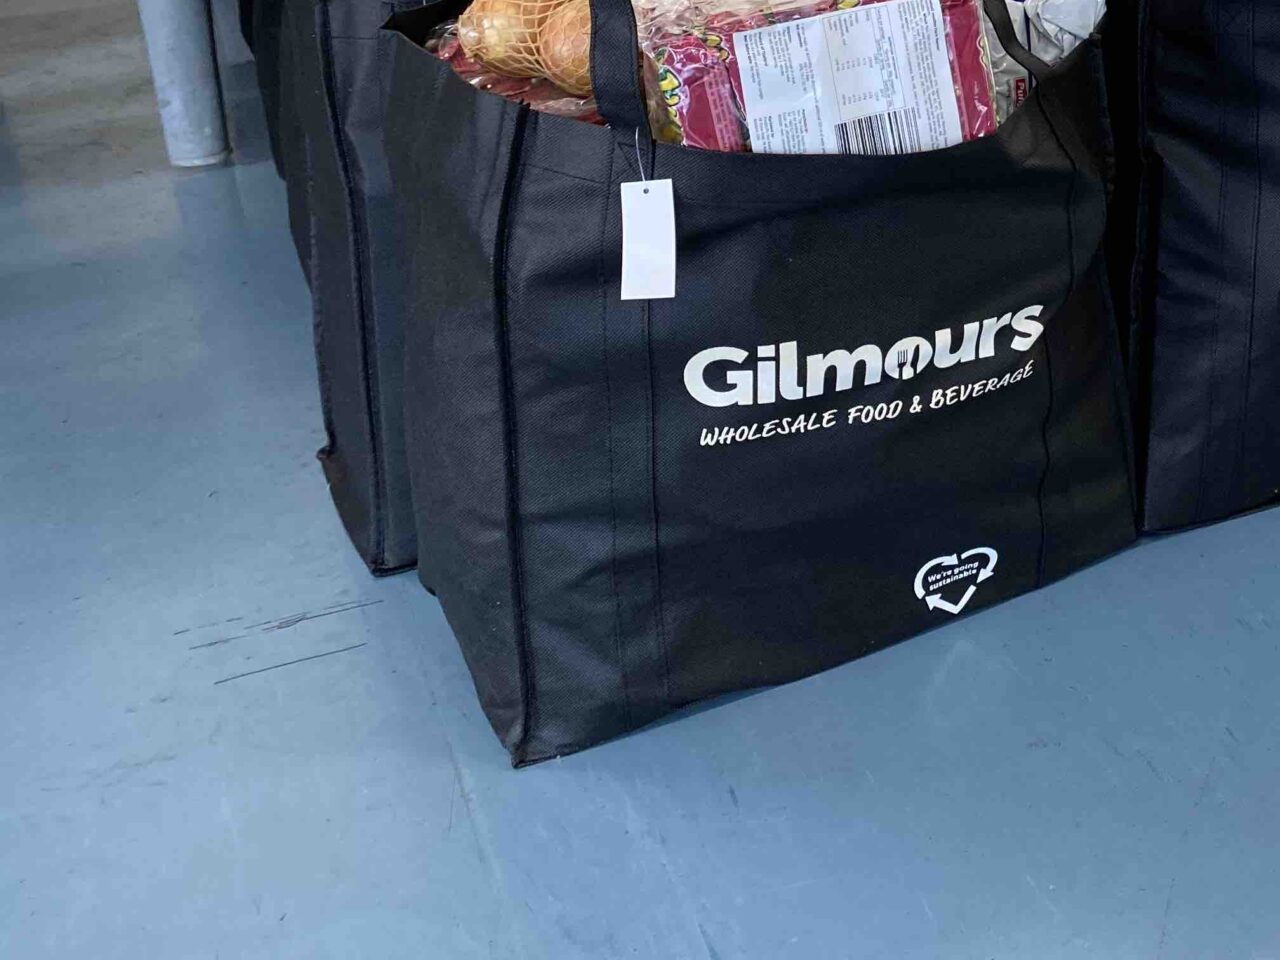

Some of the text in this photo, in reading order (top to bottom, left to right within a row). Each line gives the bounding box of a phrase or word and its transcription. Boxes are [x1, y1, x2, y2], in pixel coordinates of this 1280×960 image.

[683, 304, 1045, 407] Gilmours
[700, 409, 839, 447] WHOLESALE
[848, 400, 903, 425] FOOD
[929, 359, 1034, 410] BEVERAGE
[927, 561, 979, 583] We're going
[929, 569, 977, 591] sustainable
